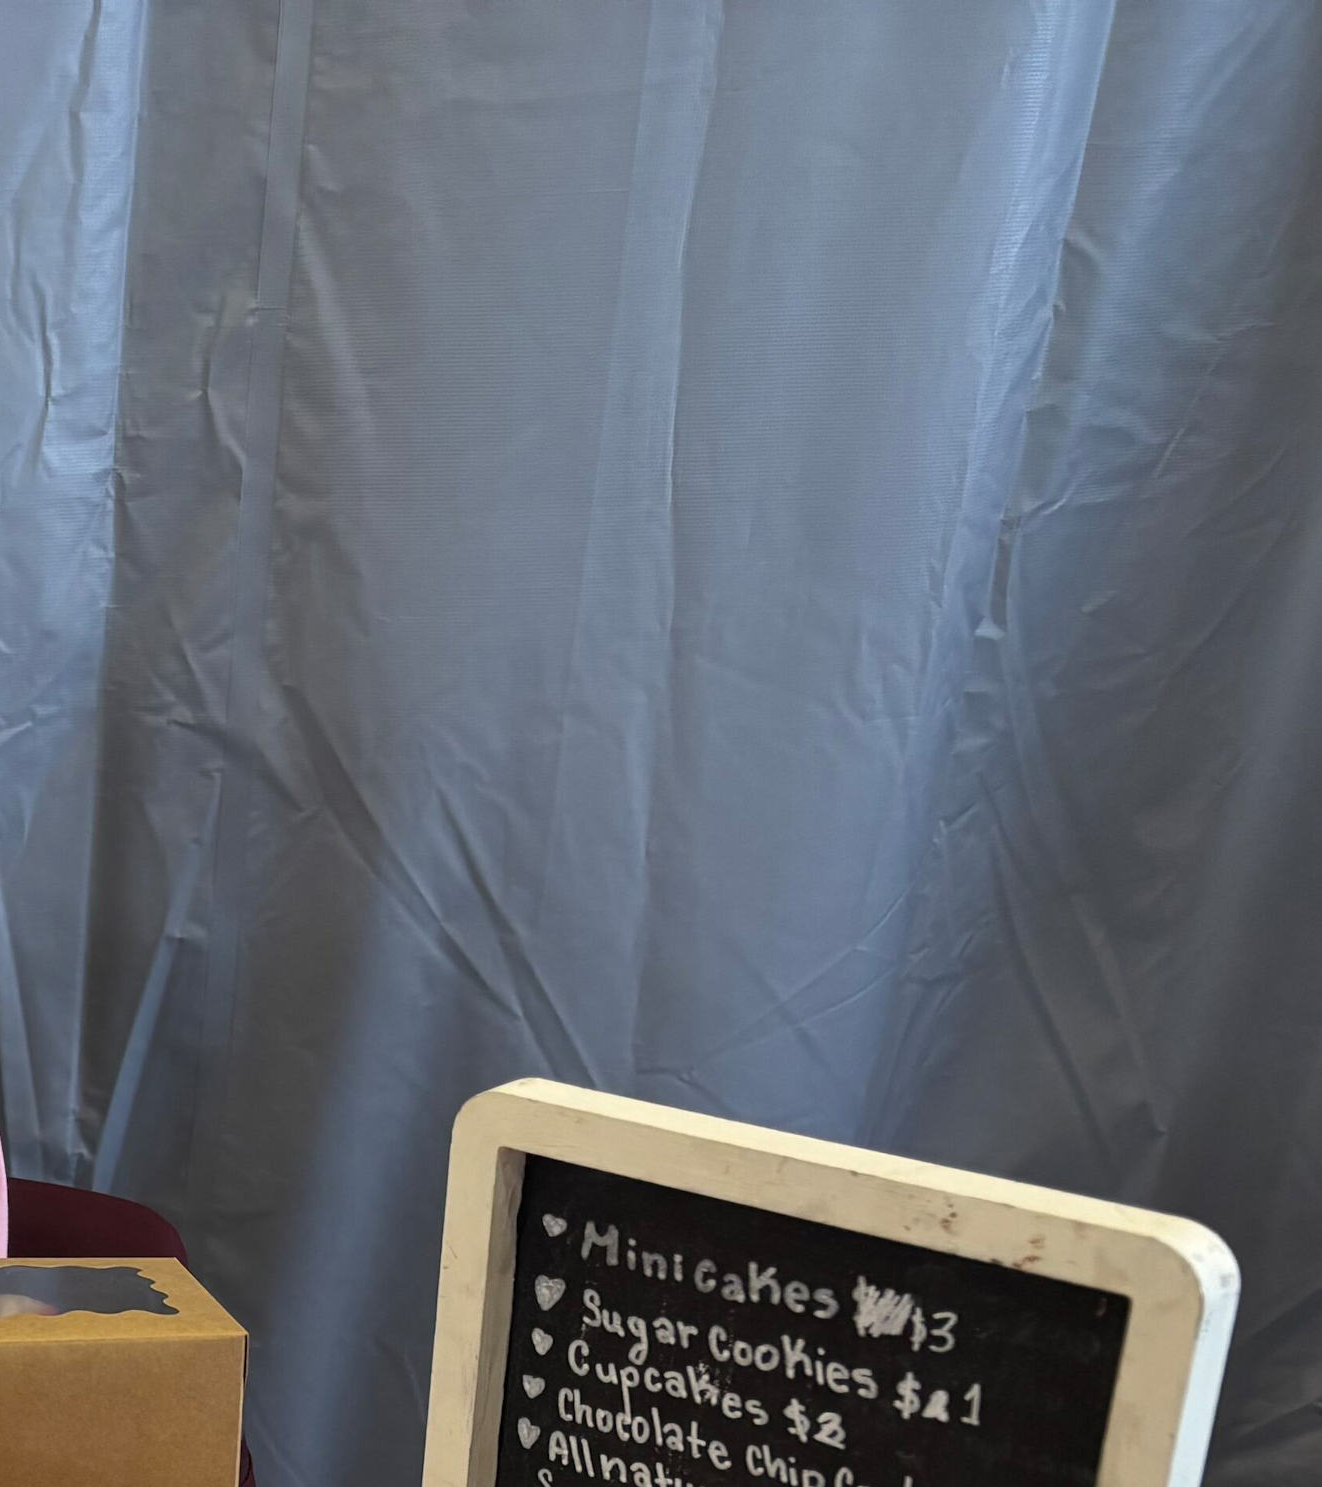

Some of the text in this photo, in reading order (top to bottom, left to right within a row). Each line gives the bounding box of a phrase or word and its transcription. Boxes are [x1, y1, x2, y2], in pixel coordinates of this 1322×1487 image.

[582, 1288, 699, 1366] Sugar
[566, 1338, 769, 1426] Cupcakes
[557, 1386, 733, 1471] Chocolate
